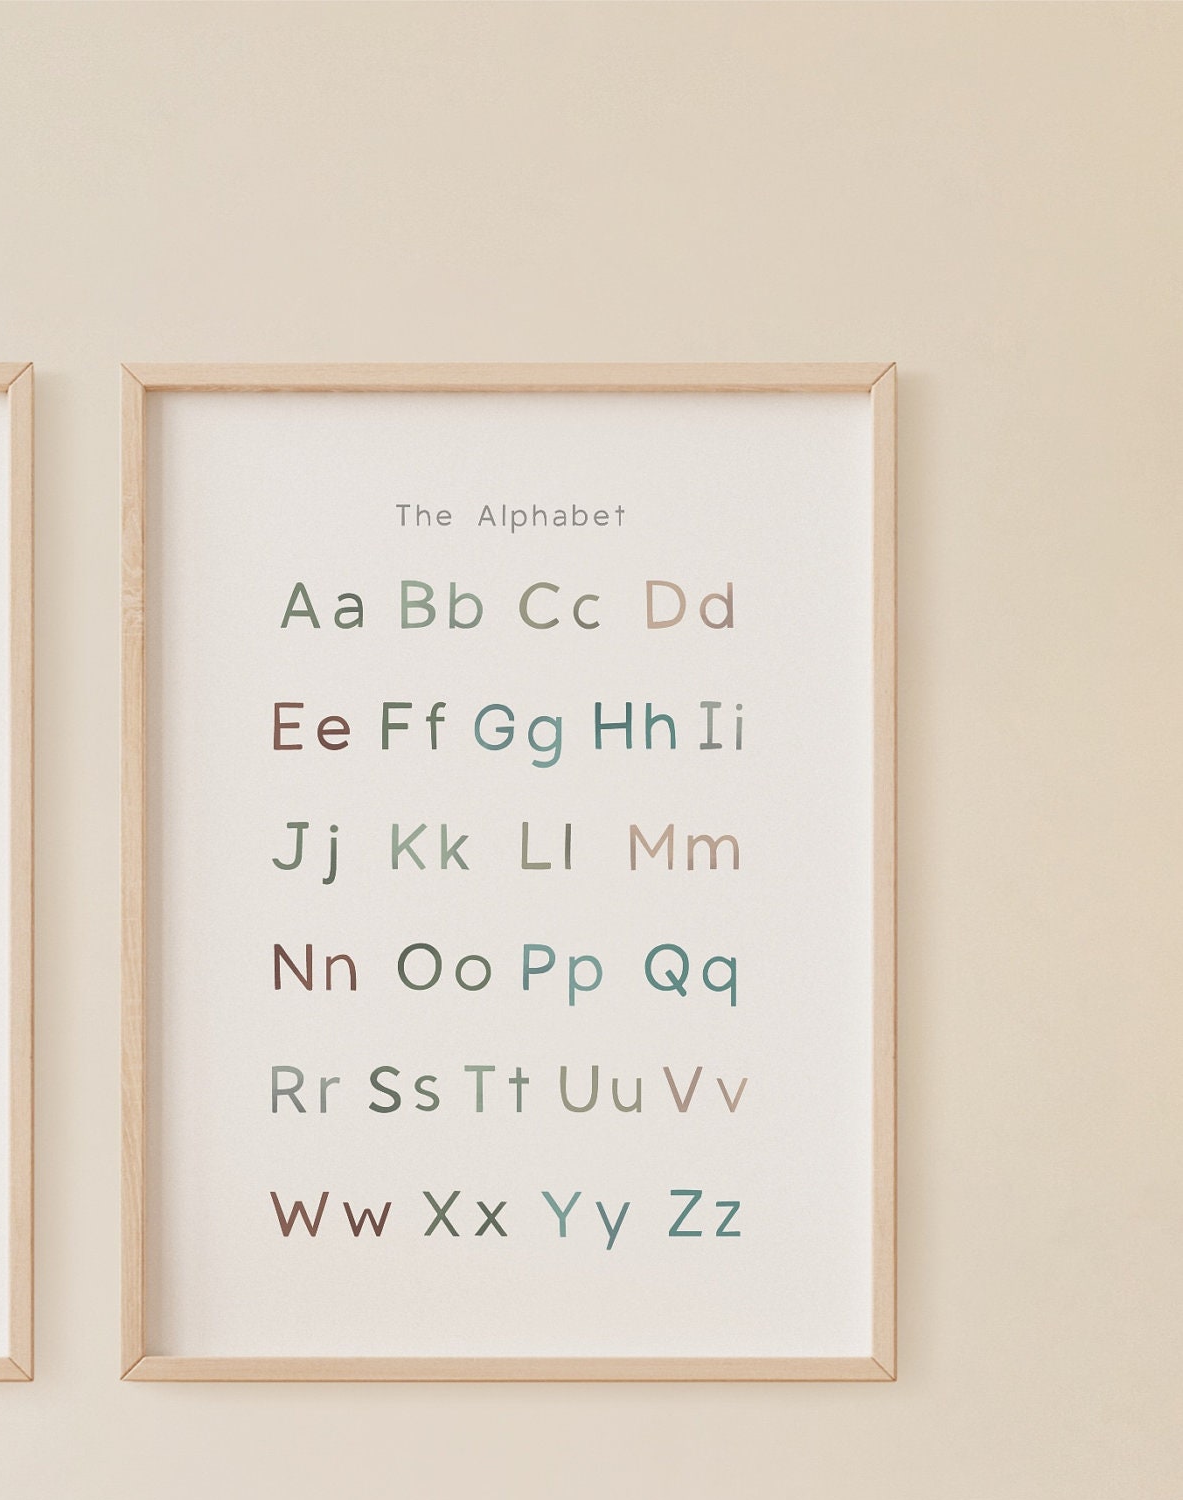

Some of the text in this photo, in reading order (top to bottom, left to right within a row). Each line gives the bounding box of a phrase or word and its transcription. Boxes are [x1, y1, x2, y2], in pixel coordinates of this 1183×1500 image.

[395, 503, 626, 535] The Alphabet
[279, 579, 735, 631] Aa Bb Cc Dd
[272, 700, 744, 769] Ee Ff Gg Hh Ii
[271, 820, 740, 886] Jj Kk Ll Mm
[272, 941, 738, 1008] Nn Oo Pp Qq
[270, 1064, 749, 1115] Rr Ss Tt Uu Vv
[269, 1188, 742, 1252] Ww Xx Yy Zz
